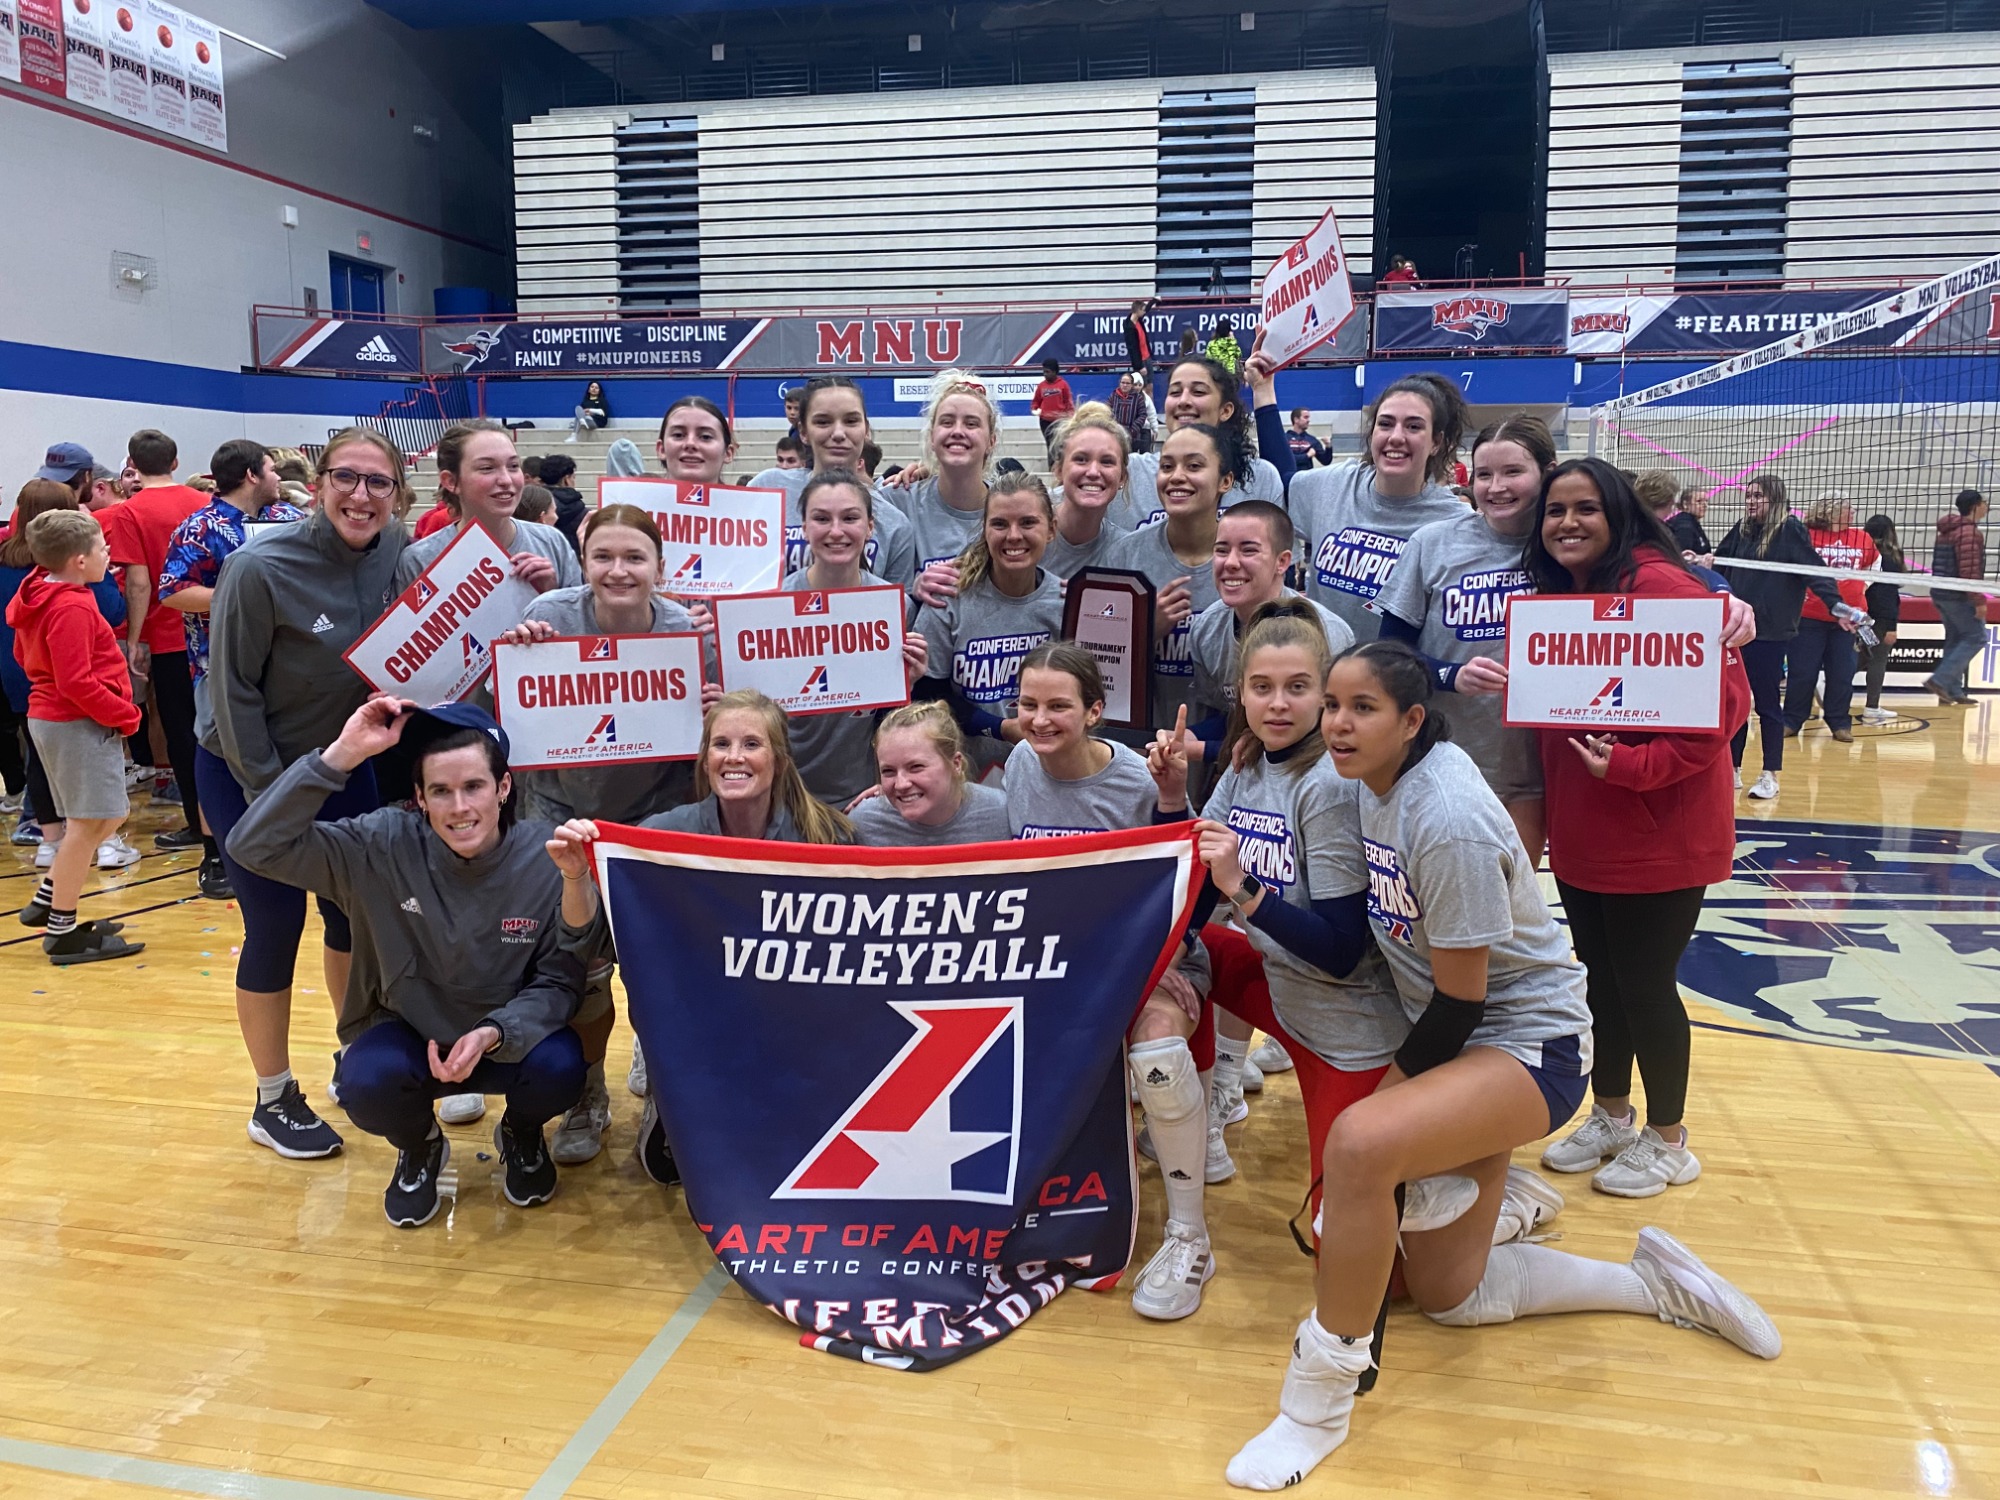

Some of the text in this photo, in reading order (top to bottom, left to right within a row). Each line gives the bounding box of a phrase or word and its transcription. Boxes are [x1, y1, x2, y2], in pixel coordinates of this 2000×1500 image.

[20, 21, 57, 50] NAIA
[111, 31, 141, 49] WOMEN'S
[67, 38, 102, 65] NAIA
[109, 40, 145, 60] BASKETBALL
[110, 53, 146, 82] NAIA
[151, 68, 184, 96] NAIA
[190, 84, 221, 111] NAIA
[1265, 245, 1339, 323] CHAMPIONS
[1918, 260, 2000, 309] MNU VOLLEYBA
[1094, 313, 1262, 334] INTERITY PASIO
[1433, 298, 1509, 326] MNU
[1571, 313, 1628, 335] MNU
[533, 325, 727, 344] COMPETITIVE DISCIPLINE
[1814, 308, 1876, 346] MNU VOLLEYBALL
[817, 319, 963, 364] MNU
[356, 351, 397, 362] adidas
[515, 351, 702, 367] FAMILY #MNUPIONEERS
[1754, 343, 1787, 368] VOLLEYBALL
[778, 382, 787, 399] 6
[1460, 372, 1473, 391] 7
[647, 511, 768, 547] AMPIONS
[1338, 529, 1407, 555] CONFEREN
[1316, 535, 1397, 586] CHAMPIO
[1321, 574, 1378, 597] 2022-23
[1463, 571, 1536, 590] CONFERE
[384, 557, 505, 684] CHAMPIONS
[1463, 627, 1506, 638] 2022
[738, 620, 890, 661] CHAMPIONS
[1080, 641, 1126, 654] TOURNAMENT
[1527, 632, 1704, 667] CHAMPIONS
[1888, 648, 1944, 658] MMOTH
[953, 654, 1025, 689] CHAMP
[1094, 654, 1121, 665] AMPION
[444, 671, 470, 700] HEART
[470, 663, 477, 672] OF
[517, 668, 686, 709] CHAMPIONS
[773, 697, 800, 705] EART
[814, 692, 861, 702] AMERICA
[1549, 708, 1588, 716] HEART
[1604, 710, 1661, 718] AMERICA
[547, 747, 585, 756] HEART
[600, 742, 653, 753] AMERICA
[1237, 836, 1295, 883] MPIONS
[1363, 840, 1396, 873] ERENCE
[1369, 869, 1419, 919] PIONS
[502, 919, 538, 932] MNU
[760, 888, 1029, 936] WOMEN'S
[722, 935, 1069, 986] VOLLEYBALL
[700, 1224, 828, 1255] ART
[841, 1225, 895, 1247] OF
[721, 1260, 860, 1275] THLETIC
